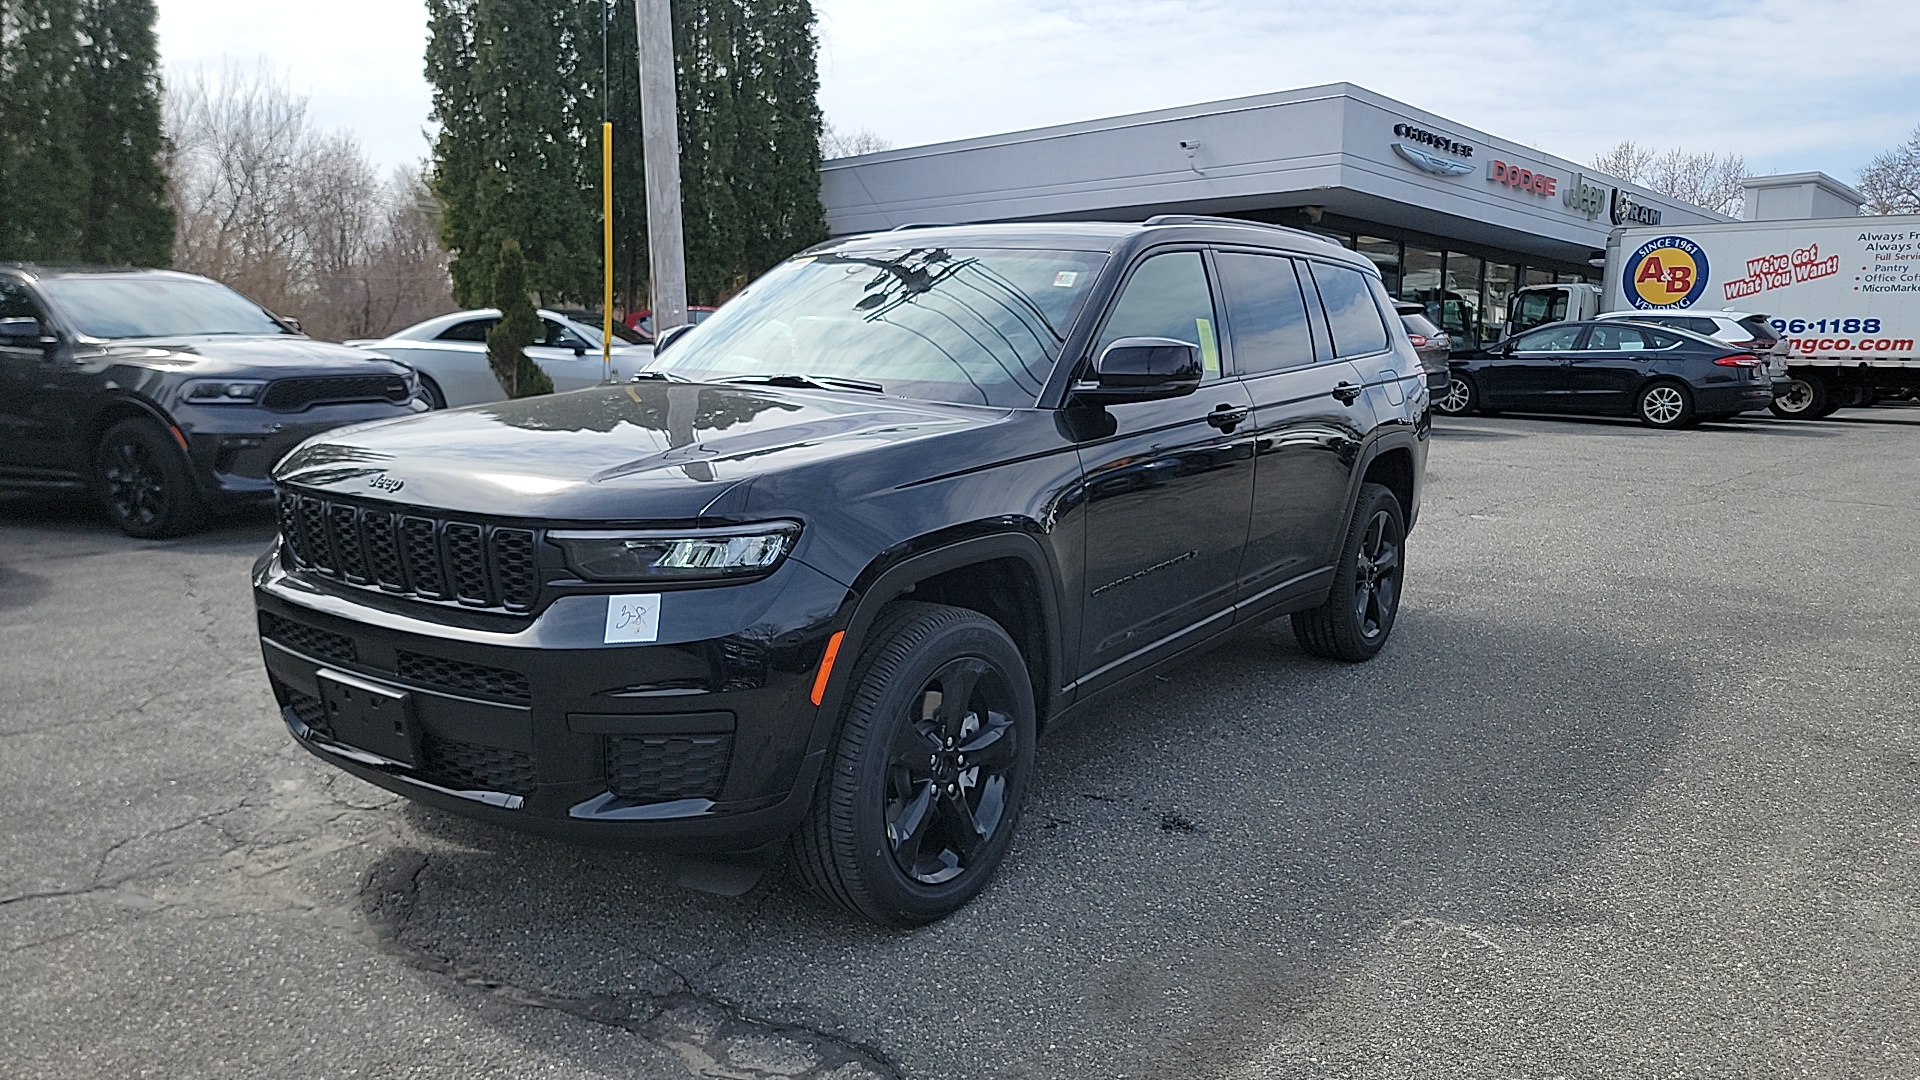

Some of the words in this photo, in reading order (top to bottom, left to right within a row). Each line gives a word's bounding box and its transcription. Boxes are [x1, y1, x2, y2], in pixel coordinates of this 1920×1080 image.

[1394, 123, 1473, 157] CHRYSLER
[1488, 159, 1557, 197] DODGE
[1564, 173, 1605, 220] Jeep
[1629, 202, 1661, 225] RAM
[1638, 238, 1671, 257] SINCE
[1674, 239, 1698, 255] 1961
[1857, 232, 1904, 242] Always
[1865, 242, 1912, 253] Always
[1747, 254, 1789, 278] We've
[1791, 243, 1818, 265] Got
[1875, 252, 1891, 261] Full
[1724, 278, 1763, 300] What
[1766, 270, 1792, 290] You
[1795, 255, 1839, 283] Want!
[1864, 273, 1896, 282] Office
[1900, 272, 1920, 282] Cof
[1874, 264, 1909, 273] Pantry
[368, 473, 404, 494] Jeep
